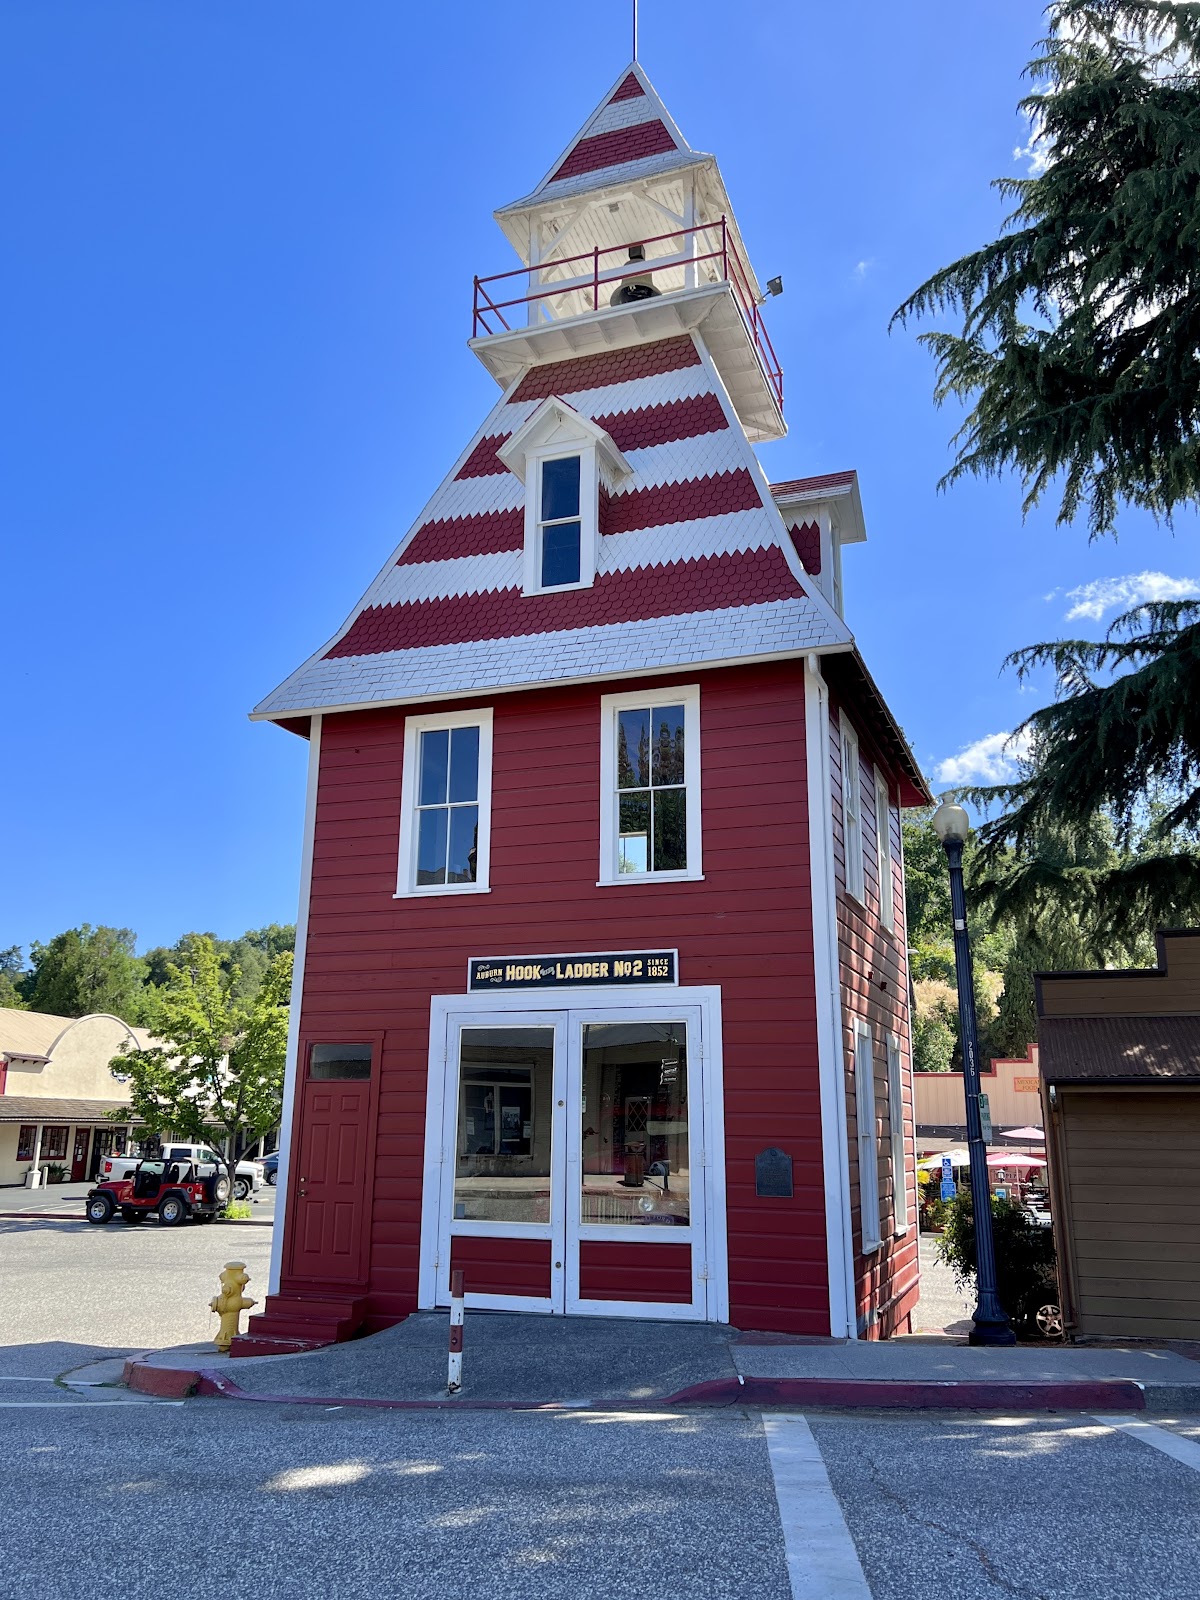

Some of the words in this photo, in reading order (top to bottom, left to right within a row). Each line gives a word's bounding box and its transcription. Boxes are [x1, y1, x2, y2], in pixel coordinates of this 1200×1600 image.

[647, 958, 669, 966] SINCE
[476, 968, 503, 980] AUBURN
[505, 964, 542, 981] HOOK
[555, 962, 609, 980] LADDER
[647, 966, 669, 977] 1852
